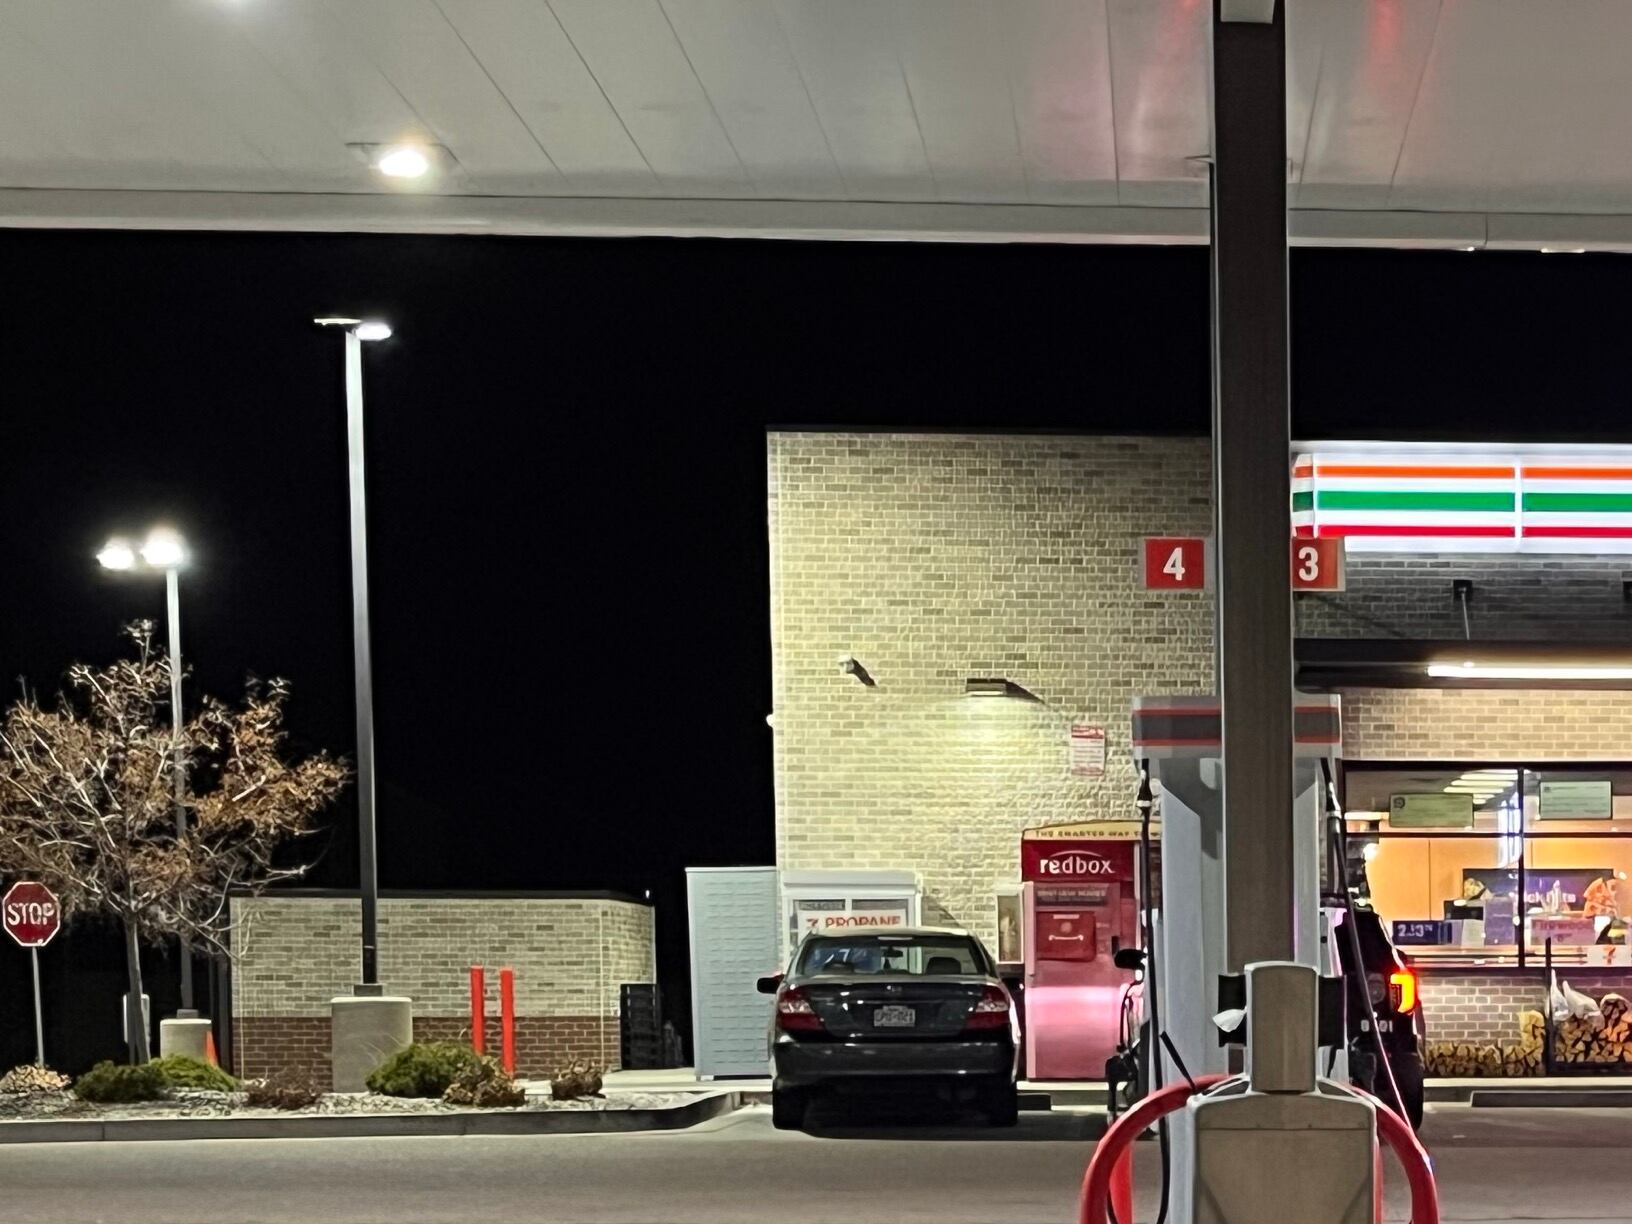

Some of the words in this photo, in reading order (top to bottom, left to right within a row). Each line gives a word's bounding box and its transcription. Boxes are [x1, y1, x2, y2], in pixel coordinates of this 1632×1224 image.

[1163, 547, 1185, 581] 4
[1298, 547, 1319, 581] 3
[1040, 855, 1114, 874] redbox
[8, 903, 55, 926] STOP
